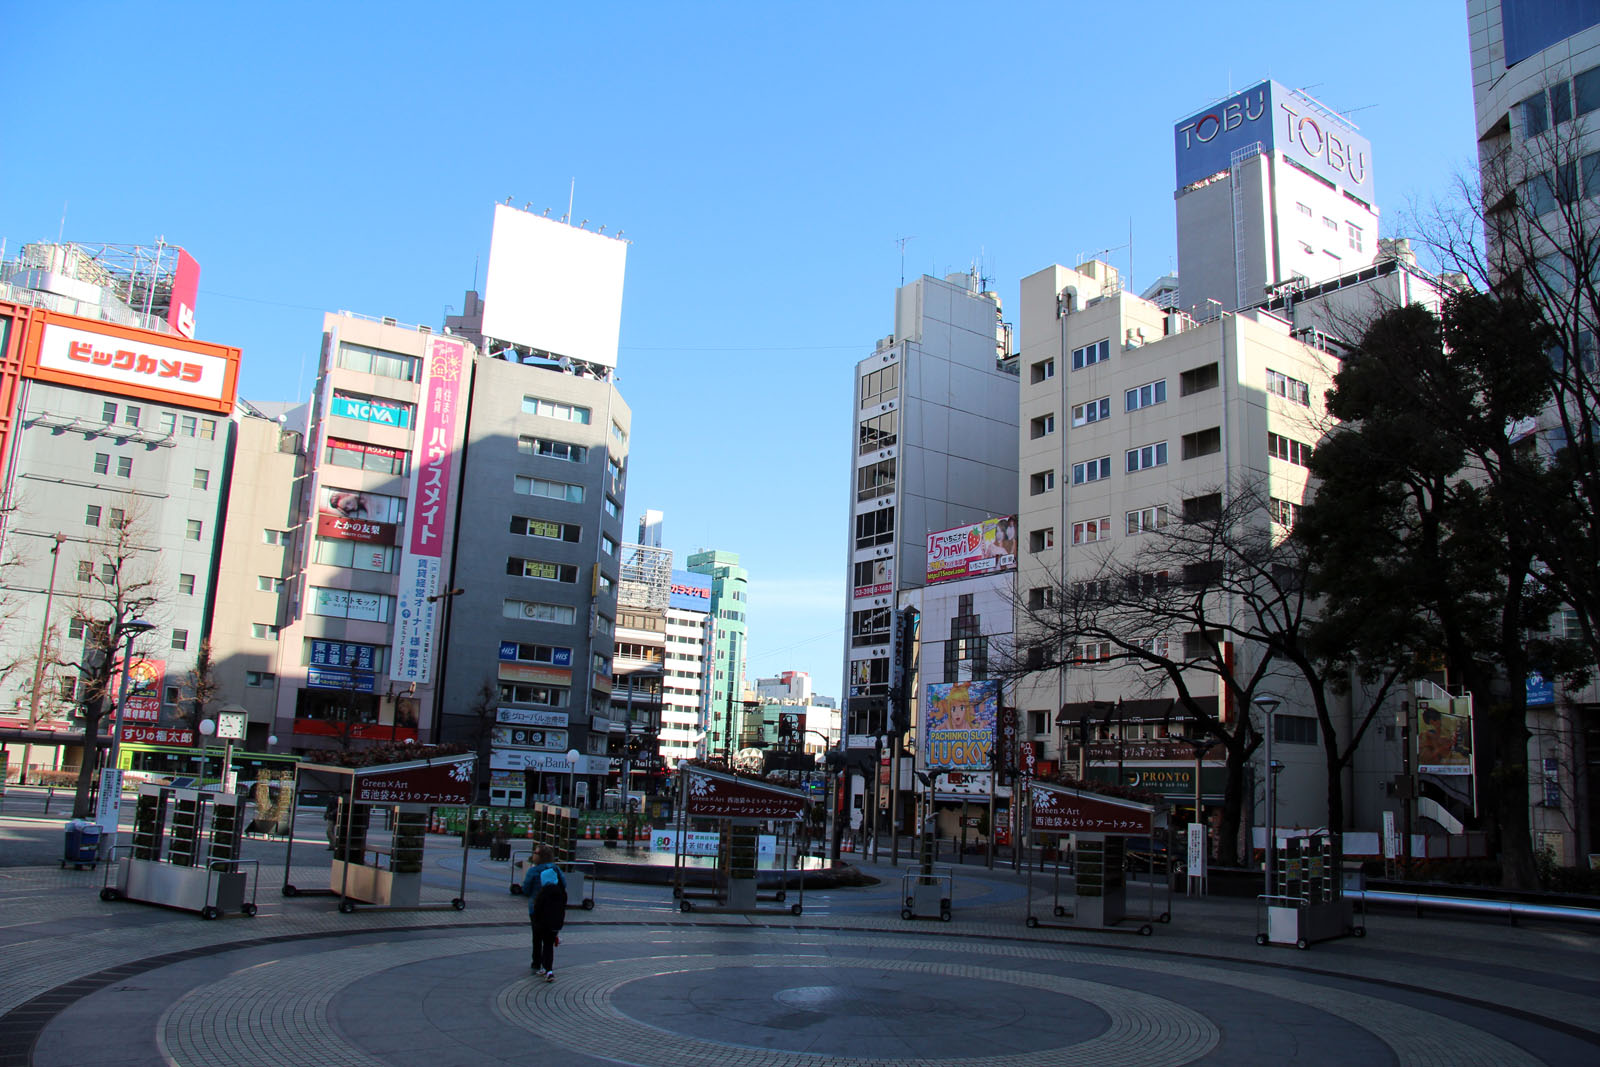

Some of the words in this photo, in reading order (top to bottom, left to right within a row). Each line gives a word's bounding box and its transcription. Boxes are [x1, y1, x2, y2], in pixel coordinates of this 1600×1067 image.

[1179, 90, 1264, 150] TOBU
[1280, 103, 1365, 184] TOBU
[69, 341, 203, 383] ビックカメラ
[347, 403, 393, 423] NOVA
[421, 428, 447, 545] ハウスメイト
[334, 519, 380, 535] たかの友梨
[112, 726, 193, 744] すりの福太郎
[931, 731, 969, 741] PACHINKO
[970, 730, 992, 741] SLOT
[930, 741, 992, 766] LUCKY
[1143, 771, 1190, 782] PRONTO
[692, 804, 797, 815] インフォメーションセンター
[656, 837, 670, 846] 80
